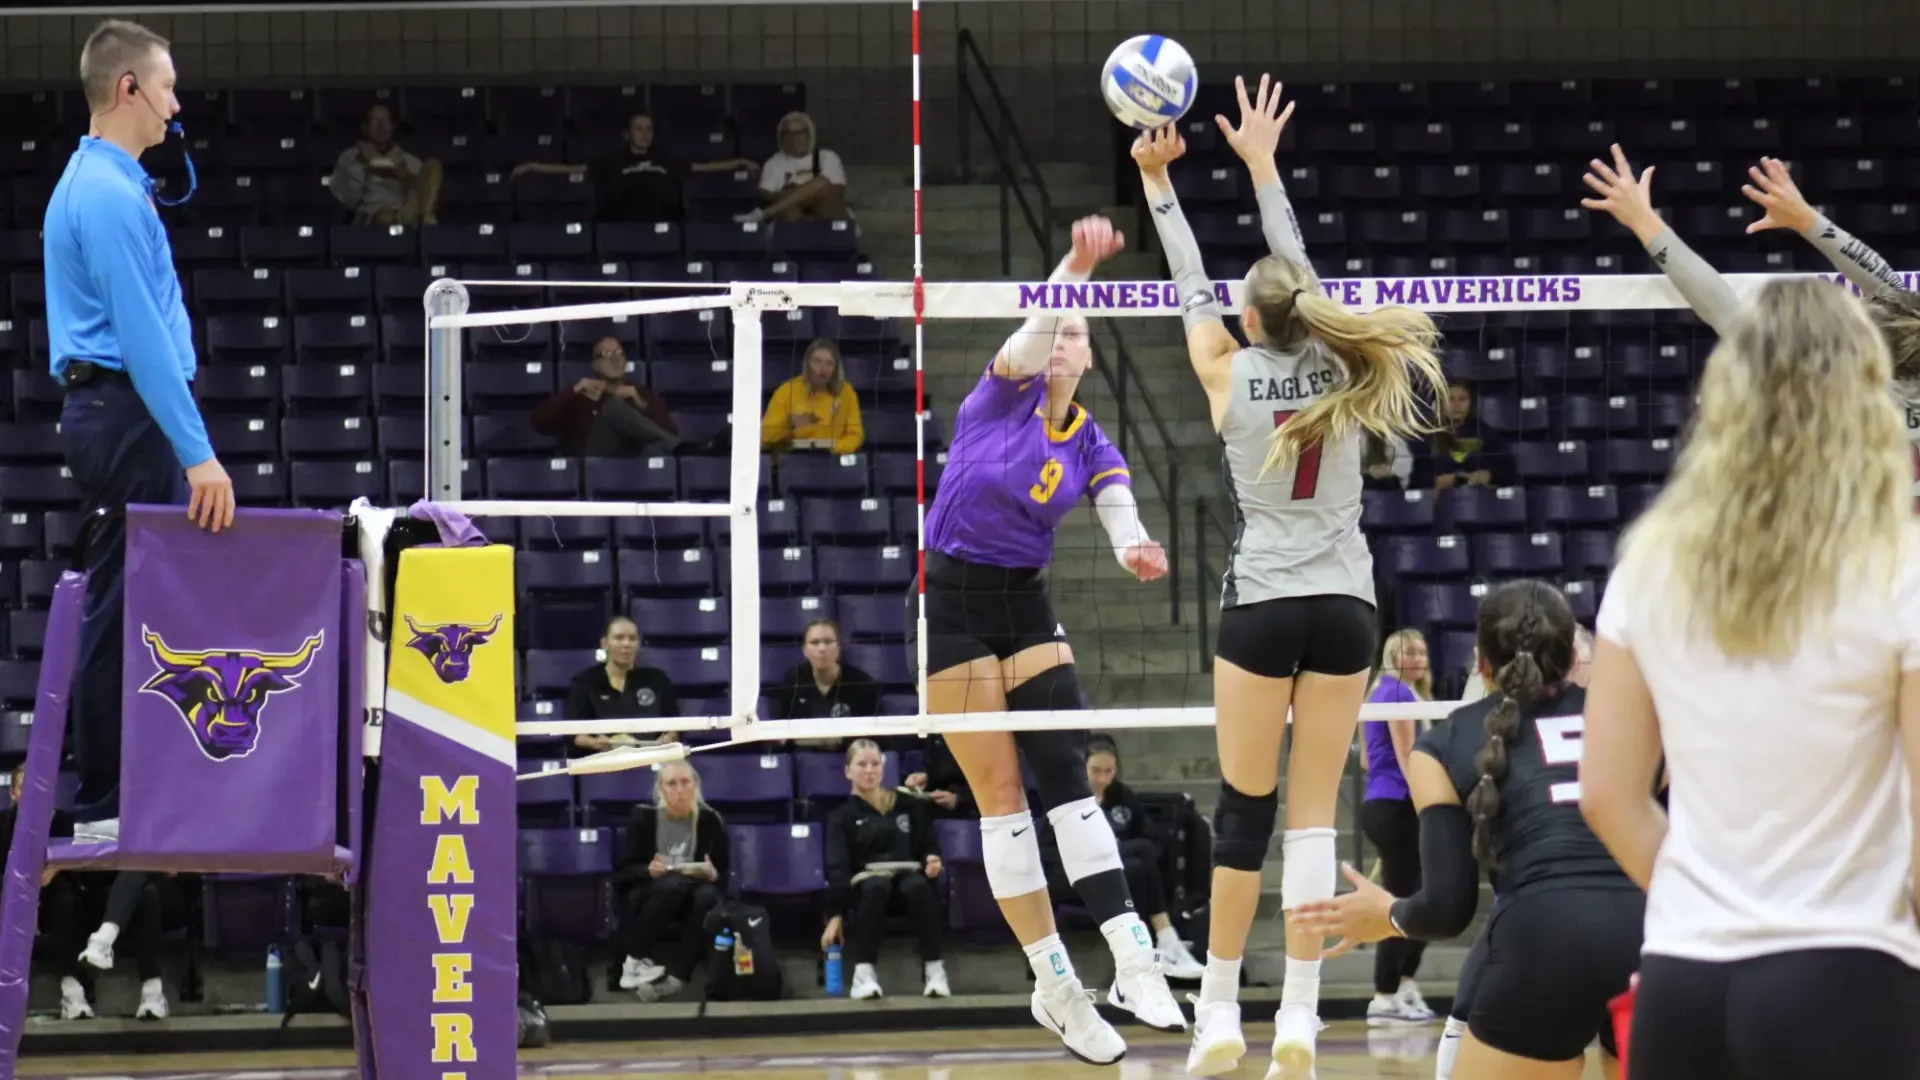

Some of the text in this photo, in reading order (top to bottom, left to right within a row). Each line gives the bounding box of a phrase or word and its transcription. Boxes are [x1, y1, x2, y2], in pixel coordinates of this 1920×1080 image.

[1018, 283, 1232, 309] MINNESOA
[1375, 277, 1581, 305] MAVERICKS
[1029, 457, 1064, 504] 9
[1273, 409, 1325, 500] 7
[420, 775, 480, 1080] MAVER
